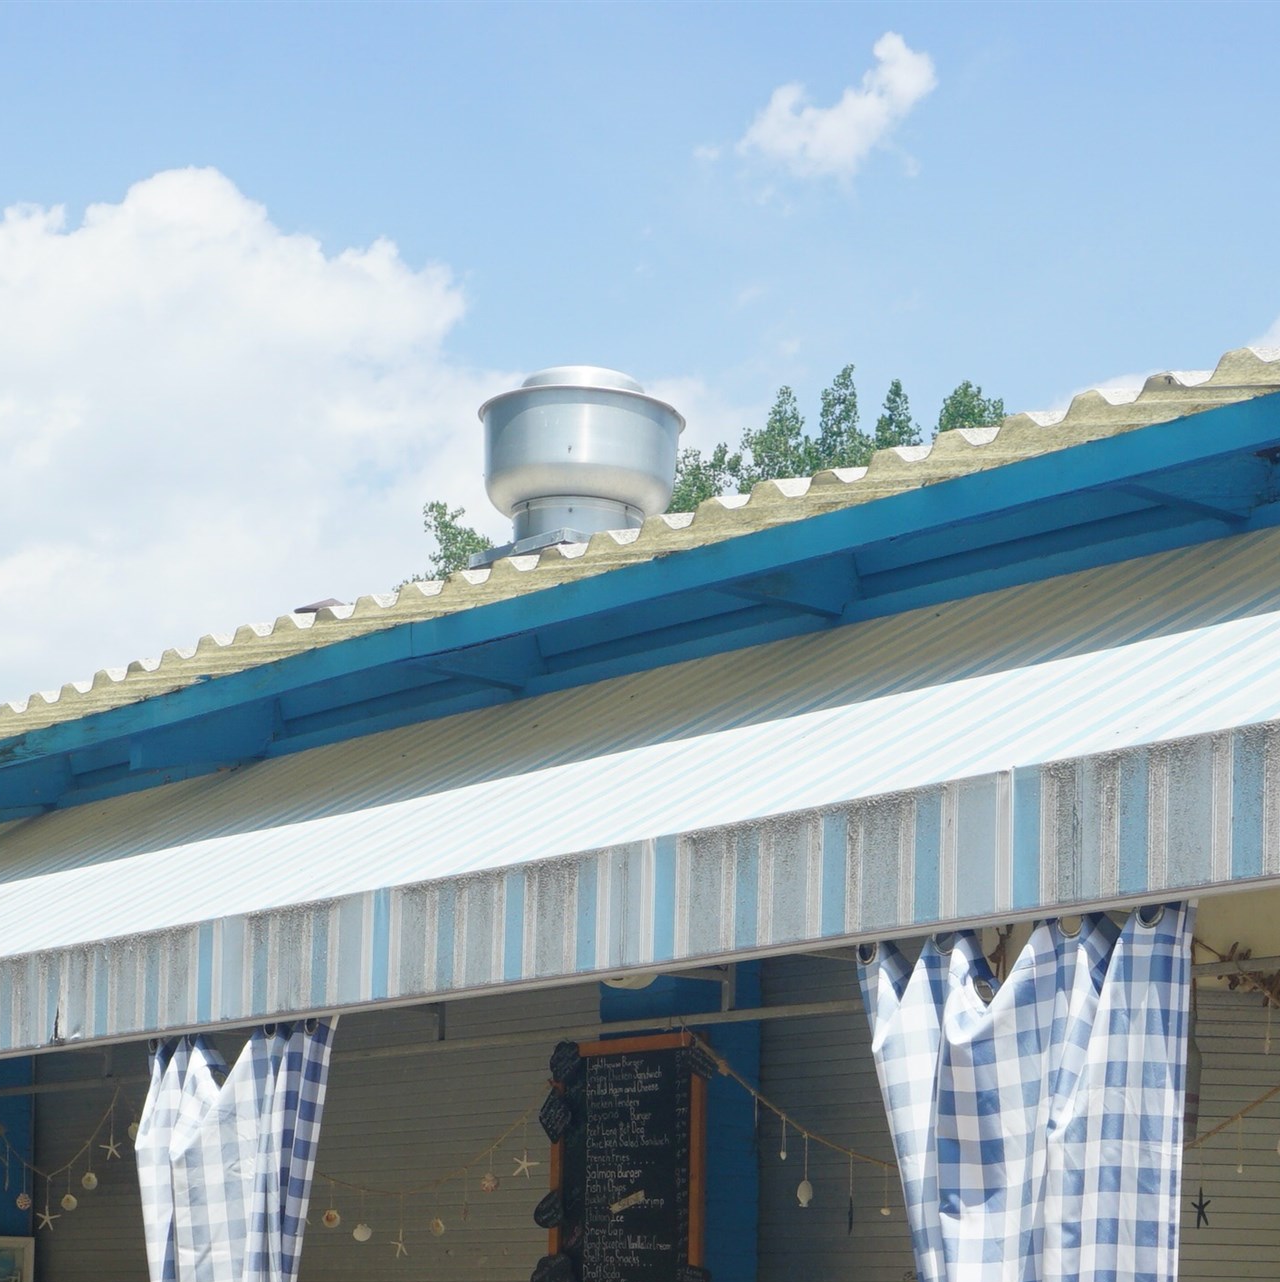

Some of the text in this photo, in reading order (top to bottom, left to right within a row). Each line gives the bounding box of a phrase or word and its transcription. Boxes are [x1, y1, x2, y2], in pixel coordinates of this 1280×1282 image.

[621, 1055, 645, 1069] Burger
[624, 1083, 637, 1094] and
[637, 1081, 659, 1093] Cheese
[587, 1107, 652, 1125] Beyond Burger
[631, 1121, 645, 1136] Dog
[585, 1136, 618, 1149] Chicken
[586, 1148, 630, 1163] French Fries
[585, 1164, 642, 1184] Salmon Burger
[585, 1179, 601, 1193] Fish
[607, 1178, 626, 1196] Chips
[611, 1214, 625, 1223] Ice
[585, 1222, 606, 1236] Snow
[607, 1221, 624, 1239] Cap
[615, 1250, 640, 1263] Snacks
